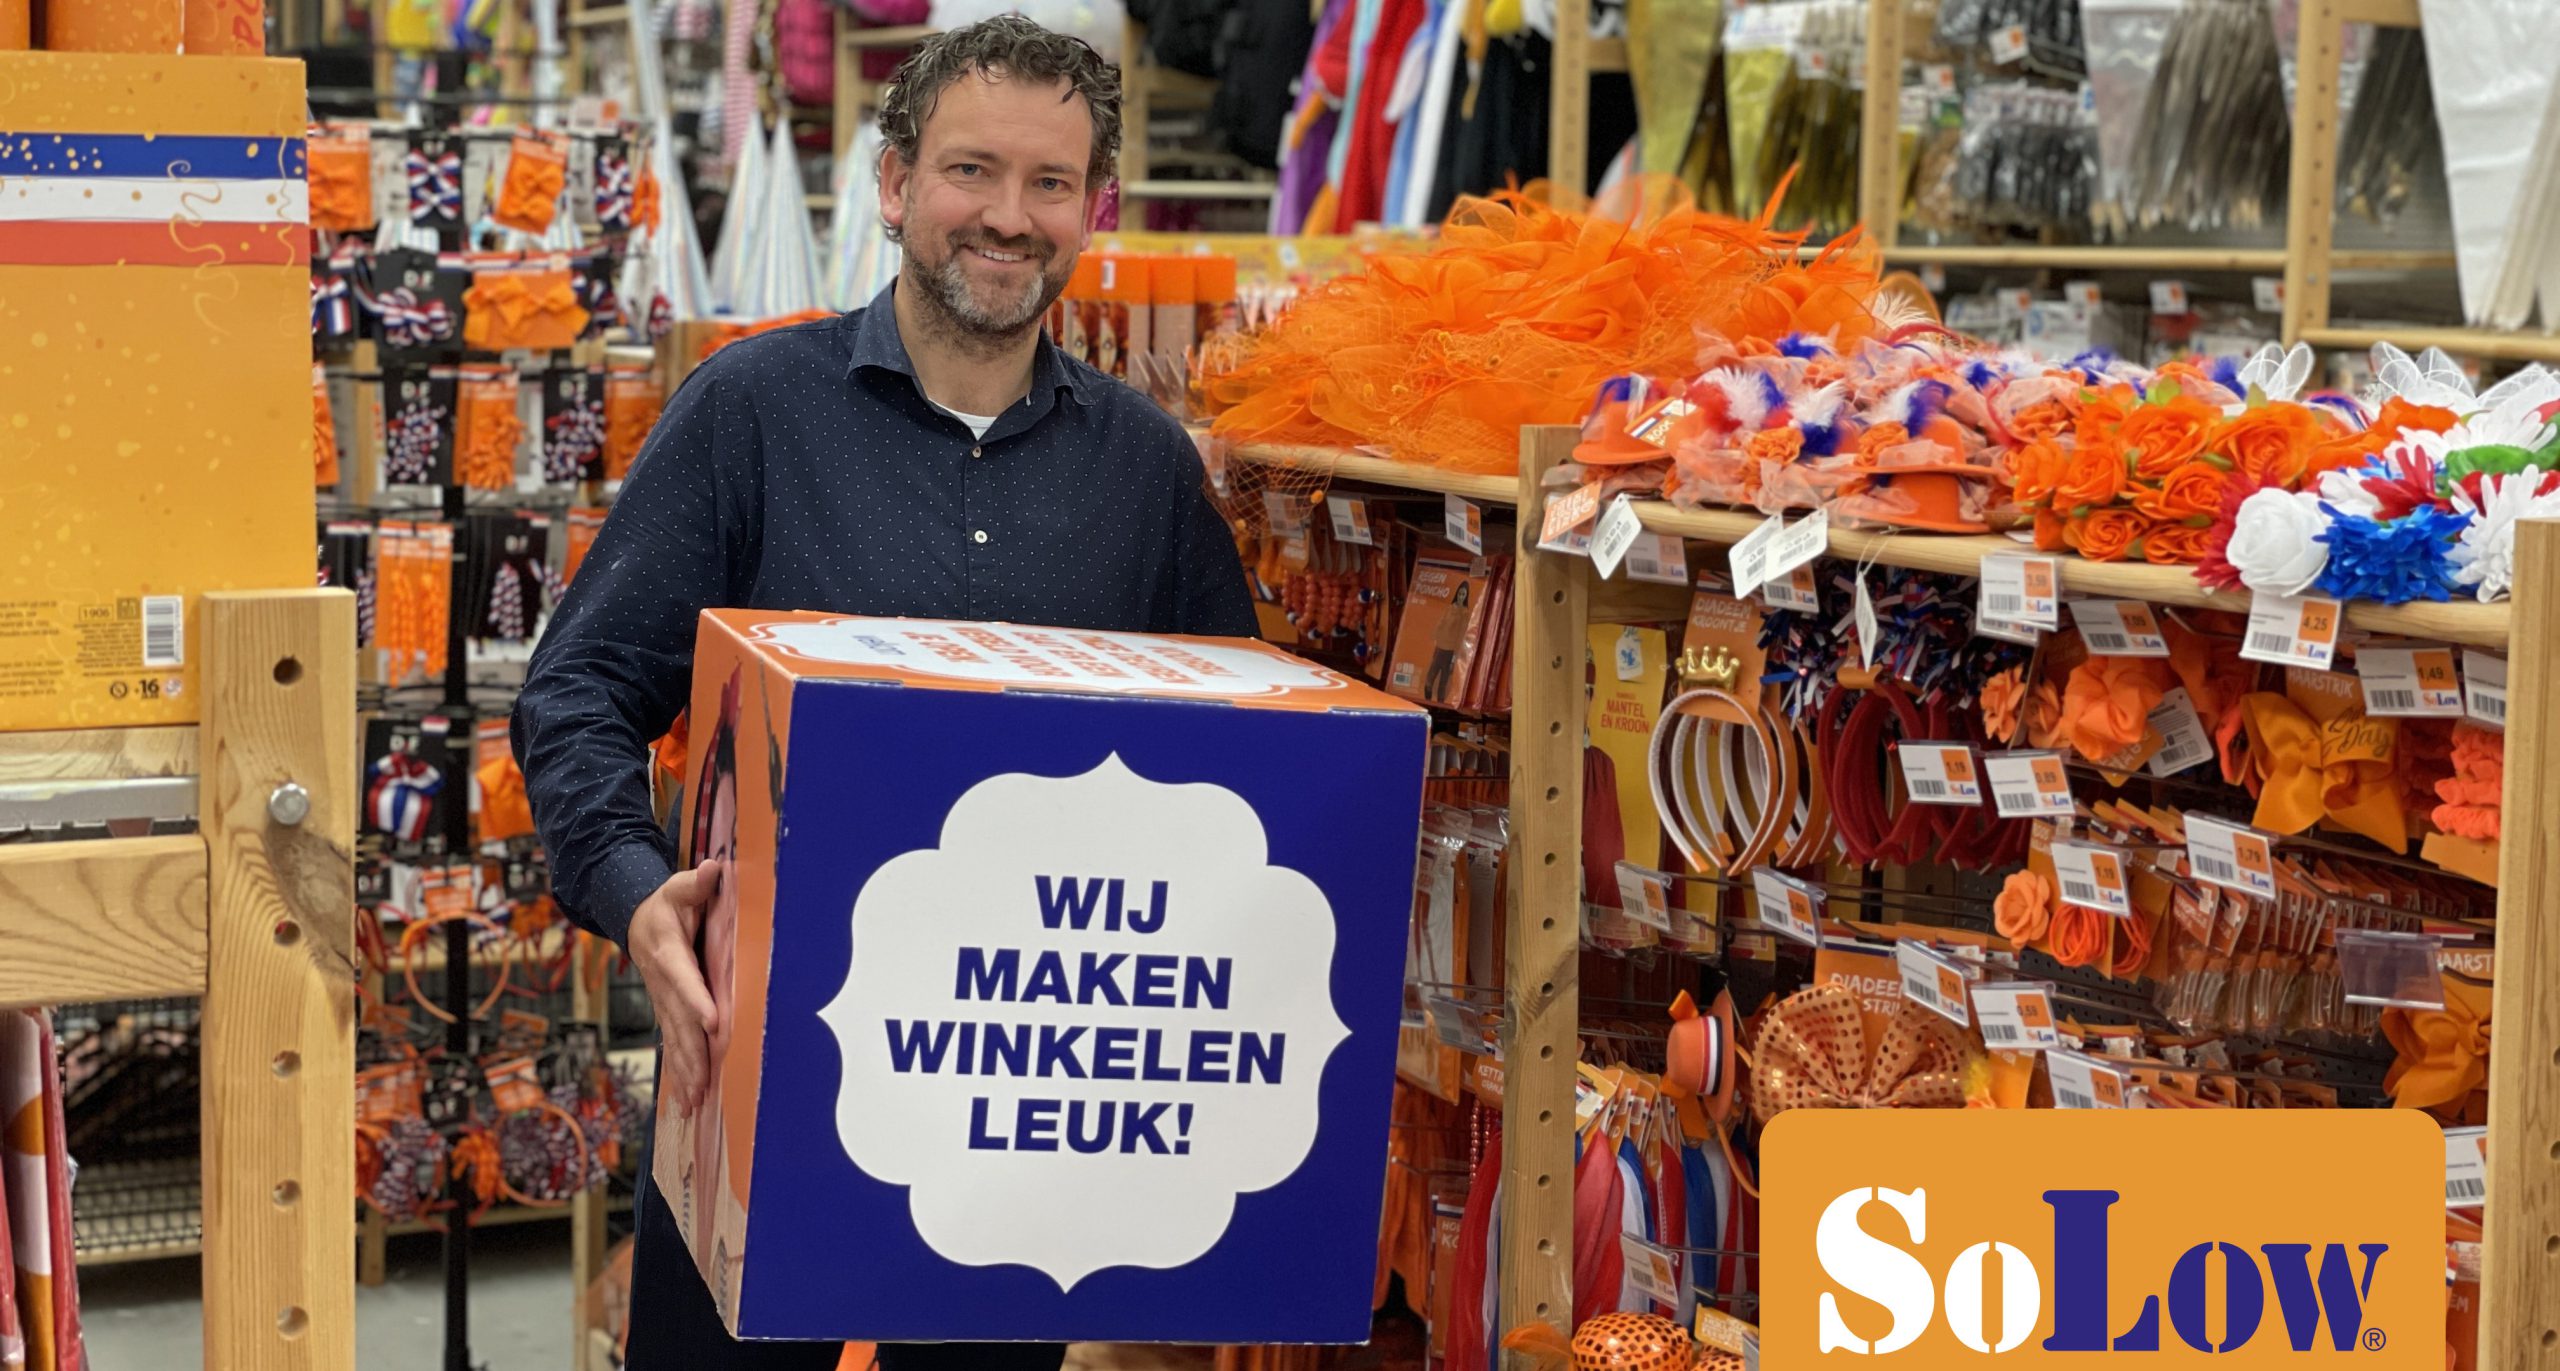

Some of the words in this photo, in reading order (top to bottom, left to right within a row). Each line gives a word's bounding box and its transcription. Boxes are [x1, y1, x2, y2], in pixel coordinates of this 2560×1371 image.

[1696, 597, 1753, 620] DIADEEM
[1601, 713, 1613, 729] EN
[1615, 716, 1650, 734] KROON
[1606, 699, 1646, 718] MANTEL
[1034, 874, 1169, 934] WIJ
[954, 946, 1233, 1010] MAKEN
[1829, 972, 1901, 998] DIADEE
[884, 1018, 1286, 1085] WINKELEN
[968, 1096, 1194, 1155] LEUK!
